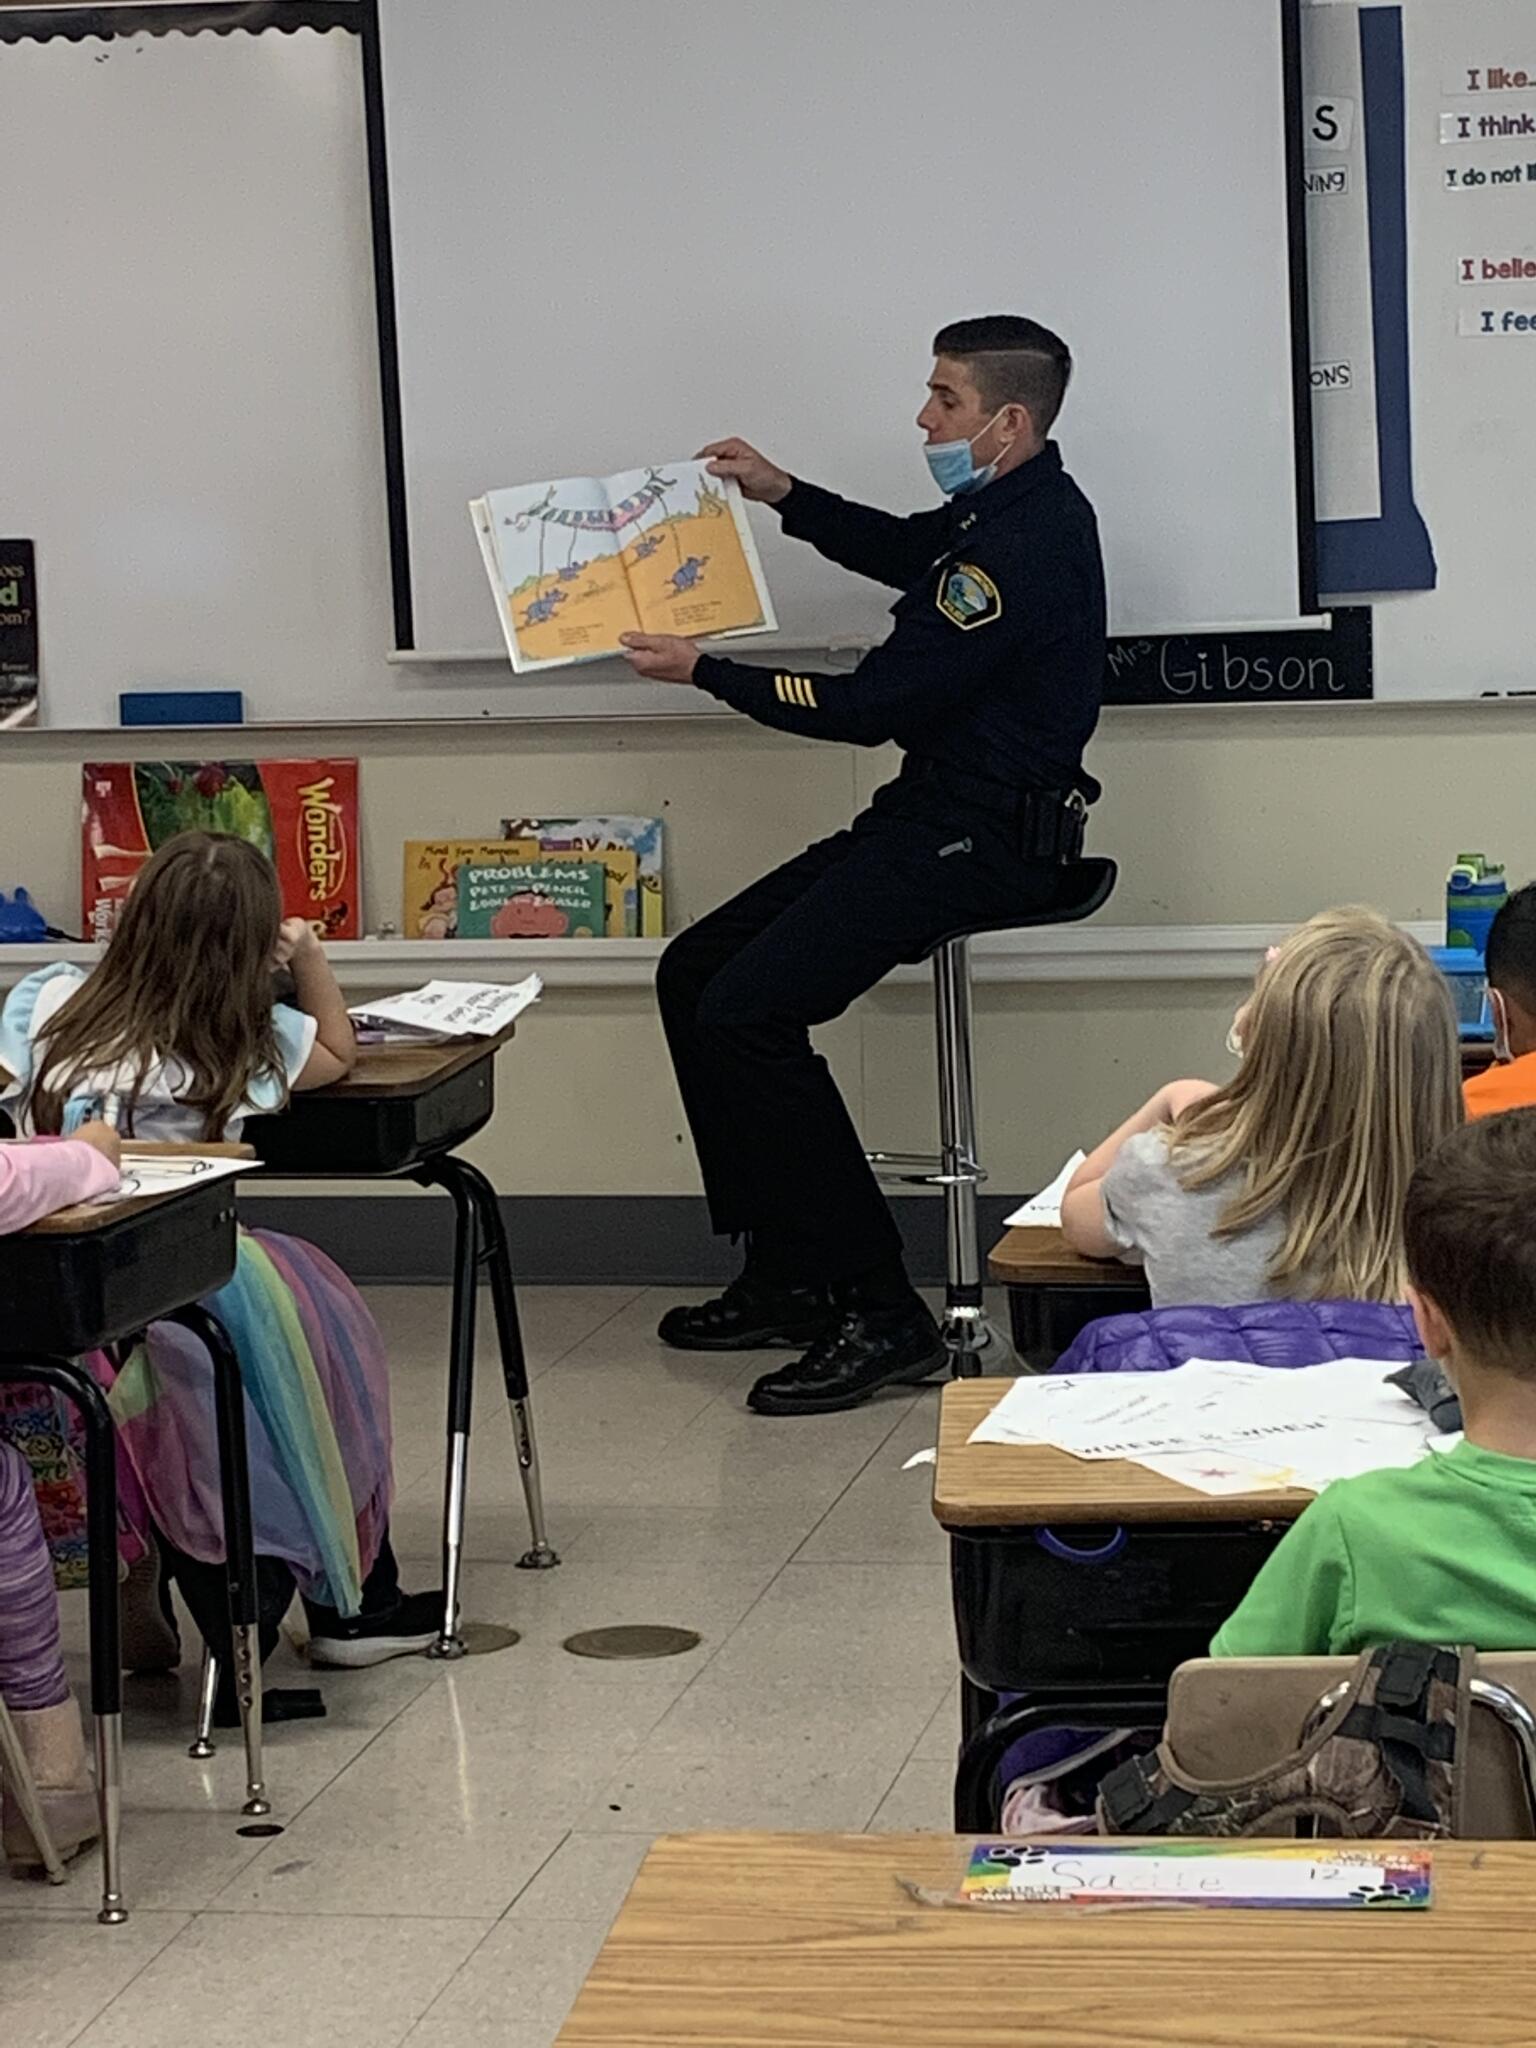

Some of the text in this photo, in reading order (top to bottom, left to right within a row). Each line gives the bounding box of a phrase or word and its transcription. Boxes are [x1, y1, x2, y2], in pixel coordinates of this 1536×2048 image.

[1467, 69, 1480, 90] I
[1312, 105, 1338, 141] S
[1457, 116, 1470, 138] I
[1446, 169, 1457, 187] I
[1462, 168, 1486, 186] do
[1491, 165, 1521, 184] not
[1461, 259, 1474, 280] I
[1481, 311, 1494, 332] I
[1160, 636, 1346, 695] Gibson
[297, 776, 343, 901] Wonders
